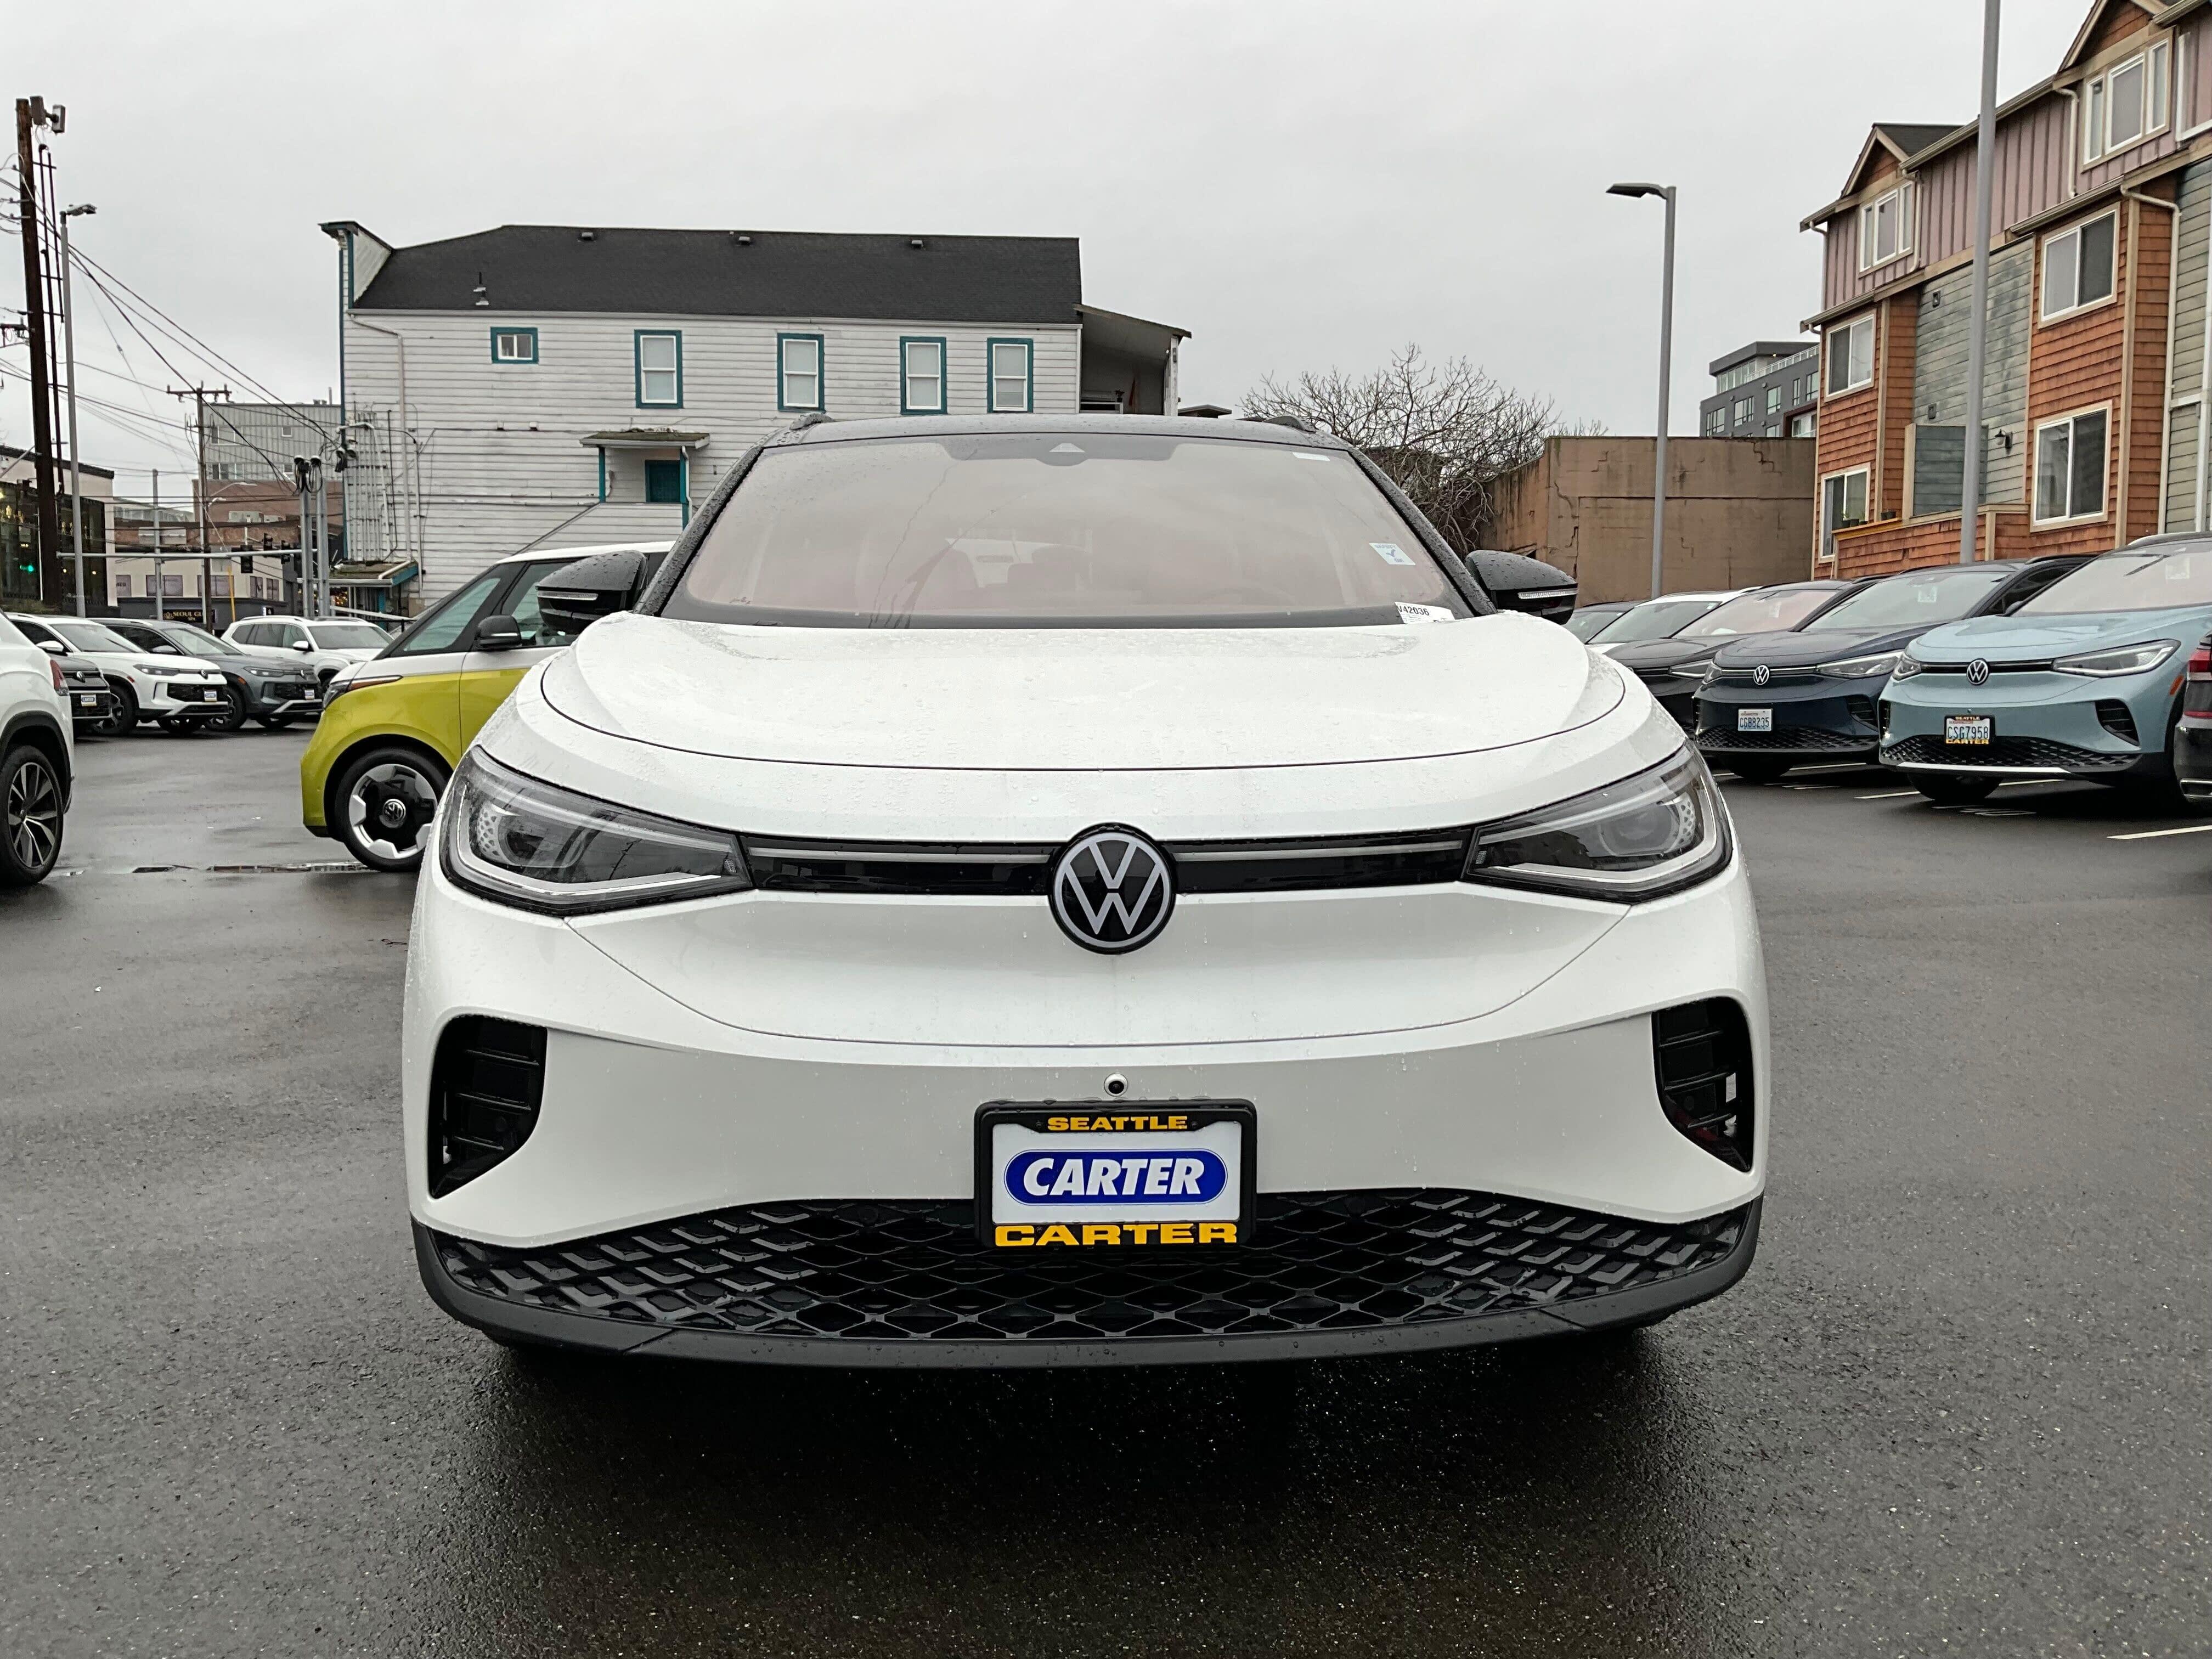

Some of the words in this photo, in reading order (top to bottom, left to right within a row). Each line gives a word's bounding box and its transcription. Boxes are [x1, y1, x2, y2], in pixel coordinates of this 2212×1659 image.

[1948, 726, 1989, 739] CSG7958
[1064, 841, 1161, 935] VW
[1047, 1115, 1188, 1131] SEATTLE
[1023, 1158, 1205, 1196] CARTER
[995, 1223, 1237, 1246] CARTER
